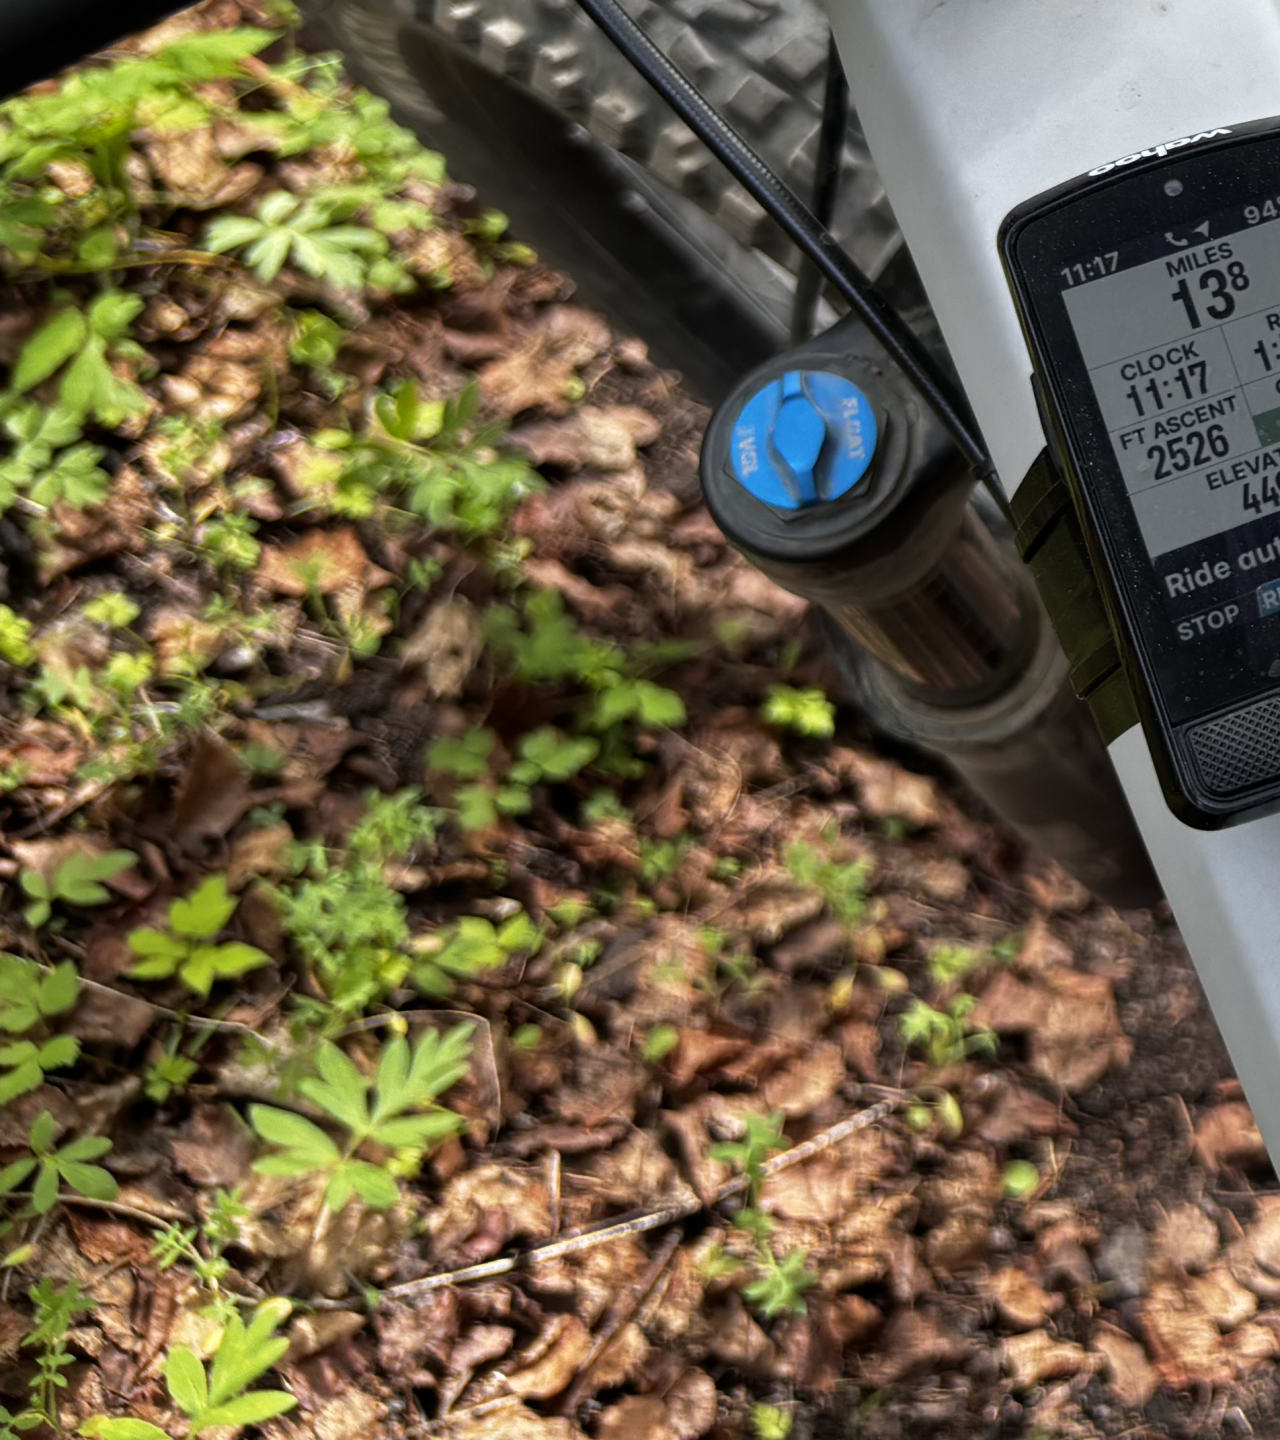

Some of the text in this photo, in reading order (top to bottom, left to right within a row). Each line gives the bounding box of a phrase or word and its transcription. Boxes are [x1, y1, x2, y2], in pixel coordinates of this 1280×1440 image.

[1087, 127, 1233, 177] wahoo
[1061, 251, 1120, 287] 11:17
[1165, 242, 1234, 278] MILES
[1120, 340, 1200, 382] CLOCK
[1126, 359, 1209, 418] 11:17
[1119, 395, 1239, 451] FT ASCENT
[1146, 423, 1230, 480] 2526
[1165, 560, 1232, 598] Ride
[1177, 604, 1241, 643] STOP
